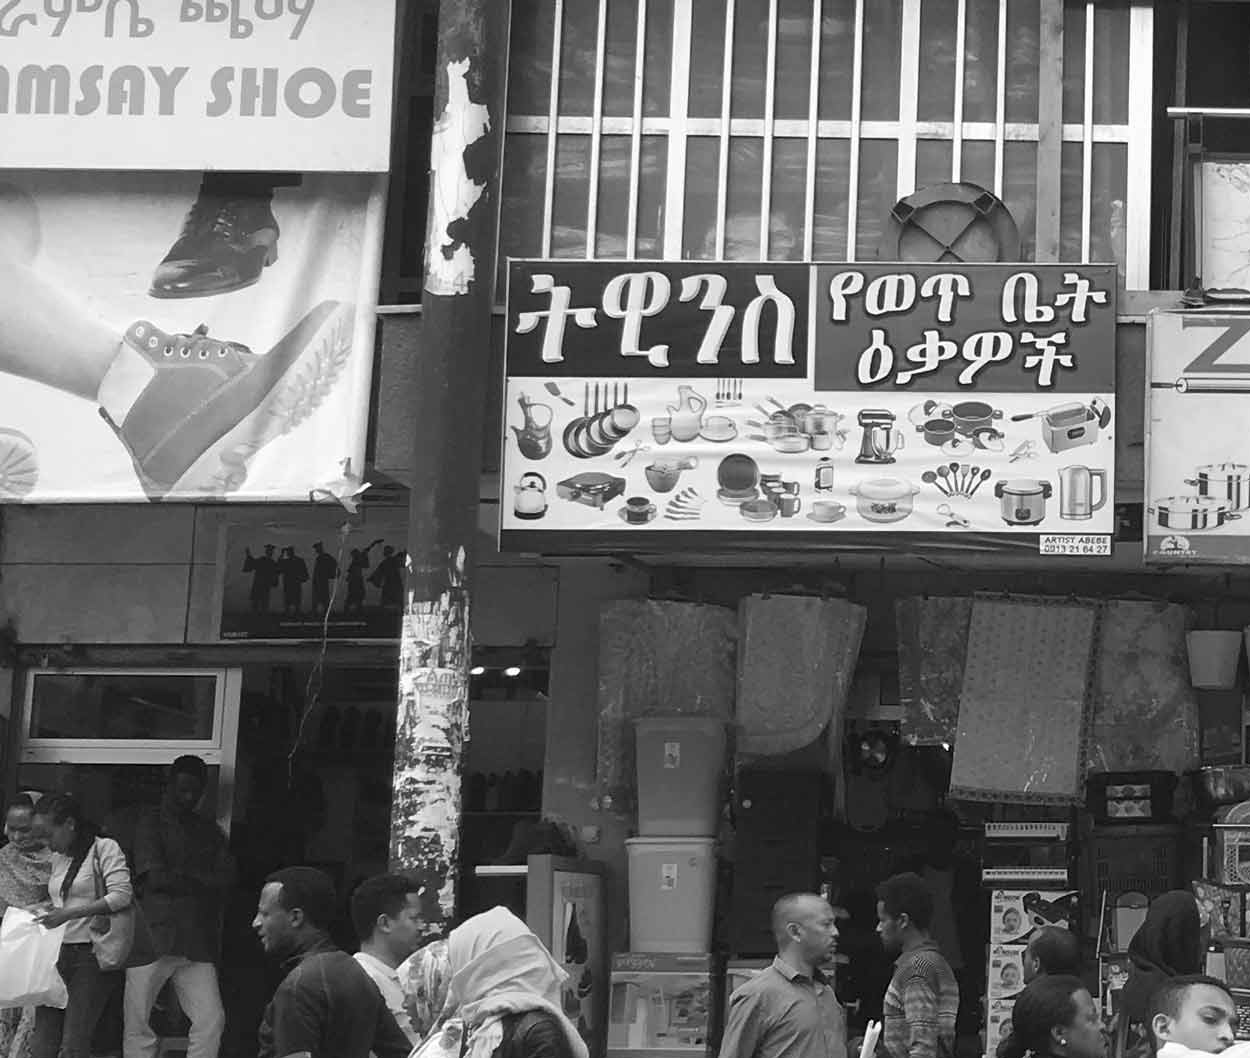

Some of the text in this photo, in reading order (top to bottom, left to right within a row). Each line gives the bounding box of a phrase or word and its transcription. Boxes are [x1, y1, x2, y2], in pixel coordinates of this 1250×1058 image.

[0, 64, 373, 118] MSAY SHOE
[516, 272, 796, 366] ትዊንስ
[830, 271, 1107, 323] የወጥ ቤት
[857, 329, 1074, 386] ዕቃዎች
[1044, 536, 1107, 545] ARTIST ABEBE
